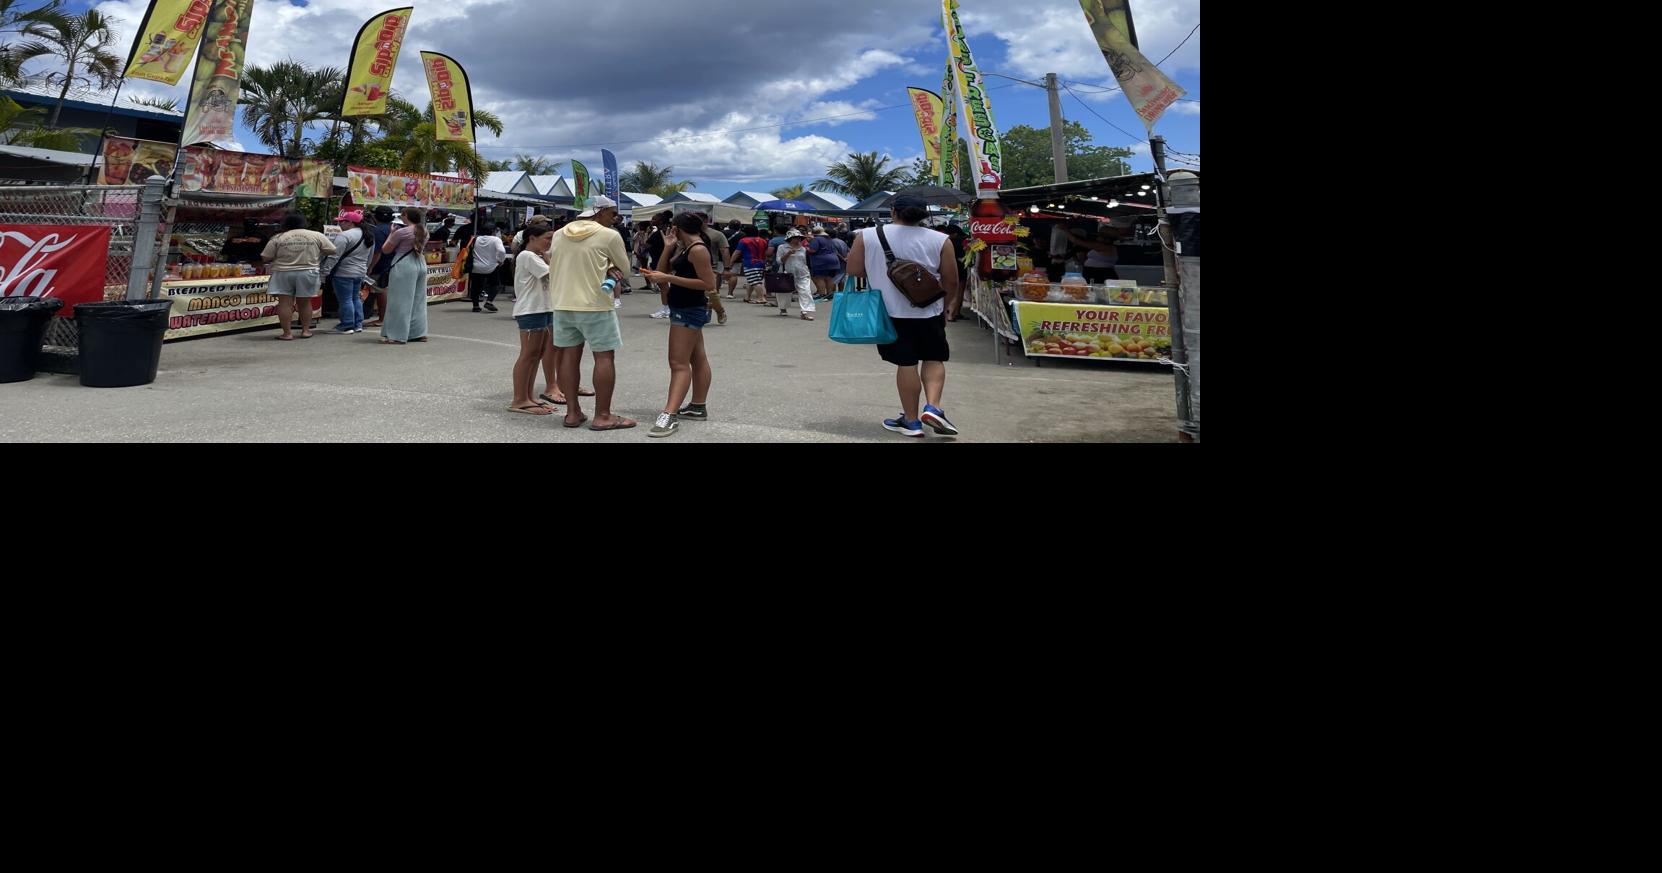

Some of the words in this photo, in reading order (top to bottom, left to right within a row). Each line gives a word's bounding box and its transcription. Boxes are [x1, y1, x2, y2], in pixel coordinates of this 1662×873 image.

[168, 285, 226, 296] BLENDED
[230, 281, 265, 291] FRESH
[188, 294, 242, 311] MANGO
[169, 307, 260, 330] WATERMELON
[1076, 310, 1123, 321] YOUR
[1040, 320, 1141, 334] REFRESHING
